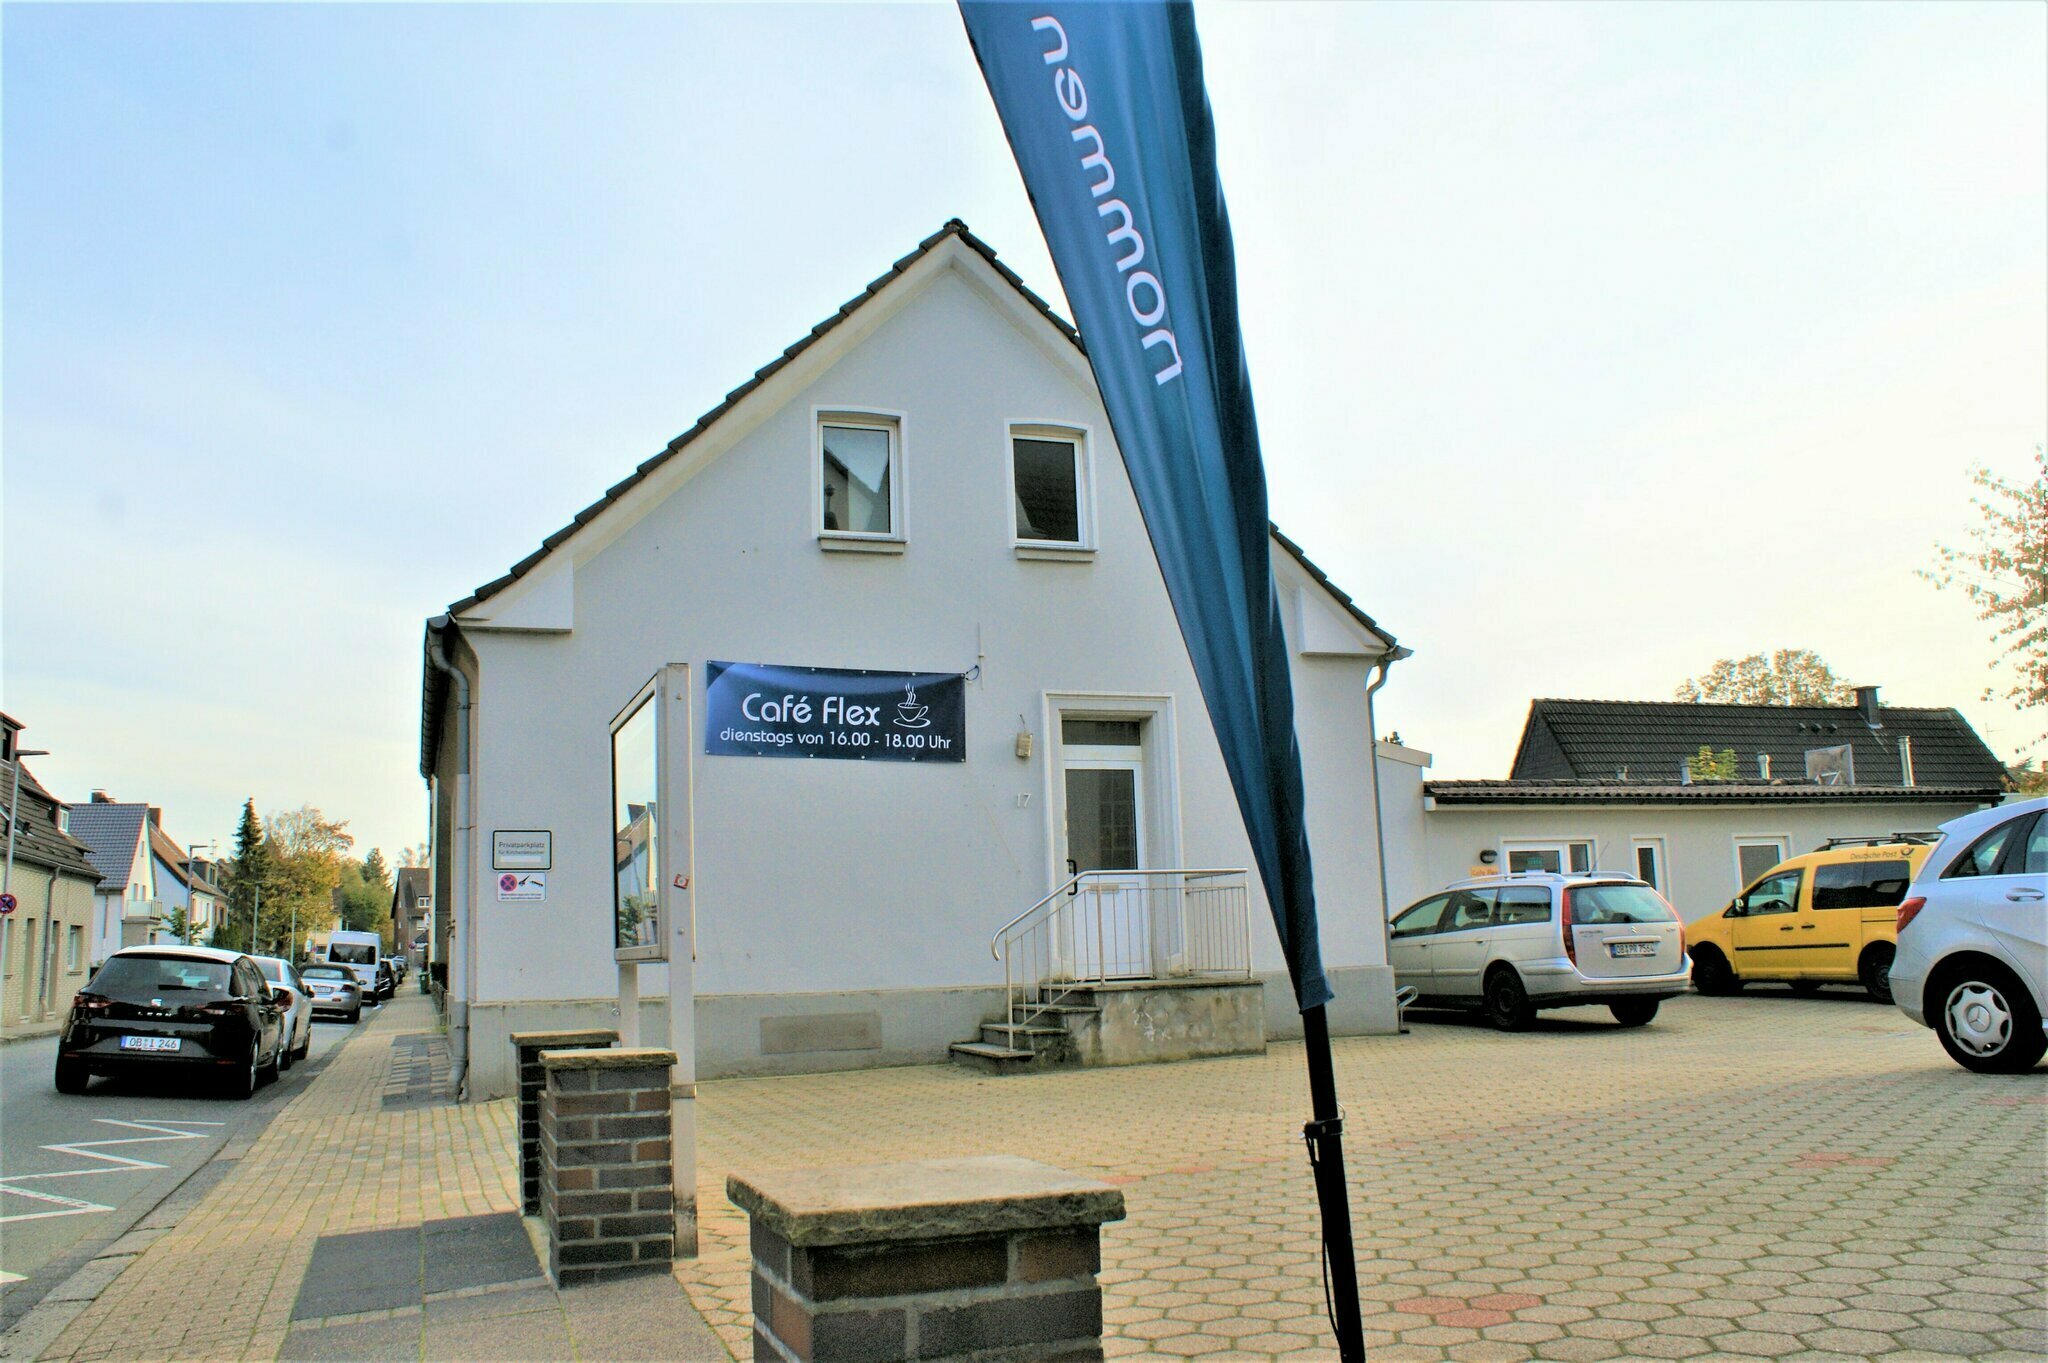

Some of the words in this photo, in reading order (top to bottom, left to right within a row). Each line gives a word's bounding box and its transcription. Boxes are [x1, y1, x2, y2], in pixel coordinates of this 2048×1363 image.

[742, 692, 812, 723] Café
[822, 696, 880, 726] Flex
[720, 727, 793, 747] dienstags
[797, 734, 823, 745] von
[829, 731, 871, 746] 16.00
[885, 733, 925, 749] 18.00
[929, 735, 952, 749] Uhr
[1017, 792, 1032, 808] 17
[498, 841, 545, 849] Privatparkplatz
[1850, 852, 1881, 860] Deutsche
[130, 1037, 143, 1047] OB
[158, 1038, 177, 1049] 246
